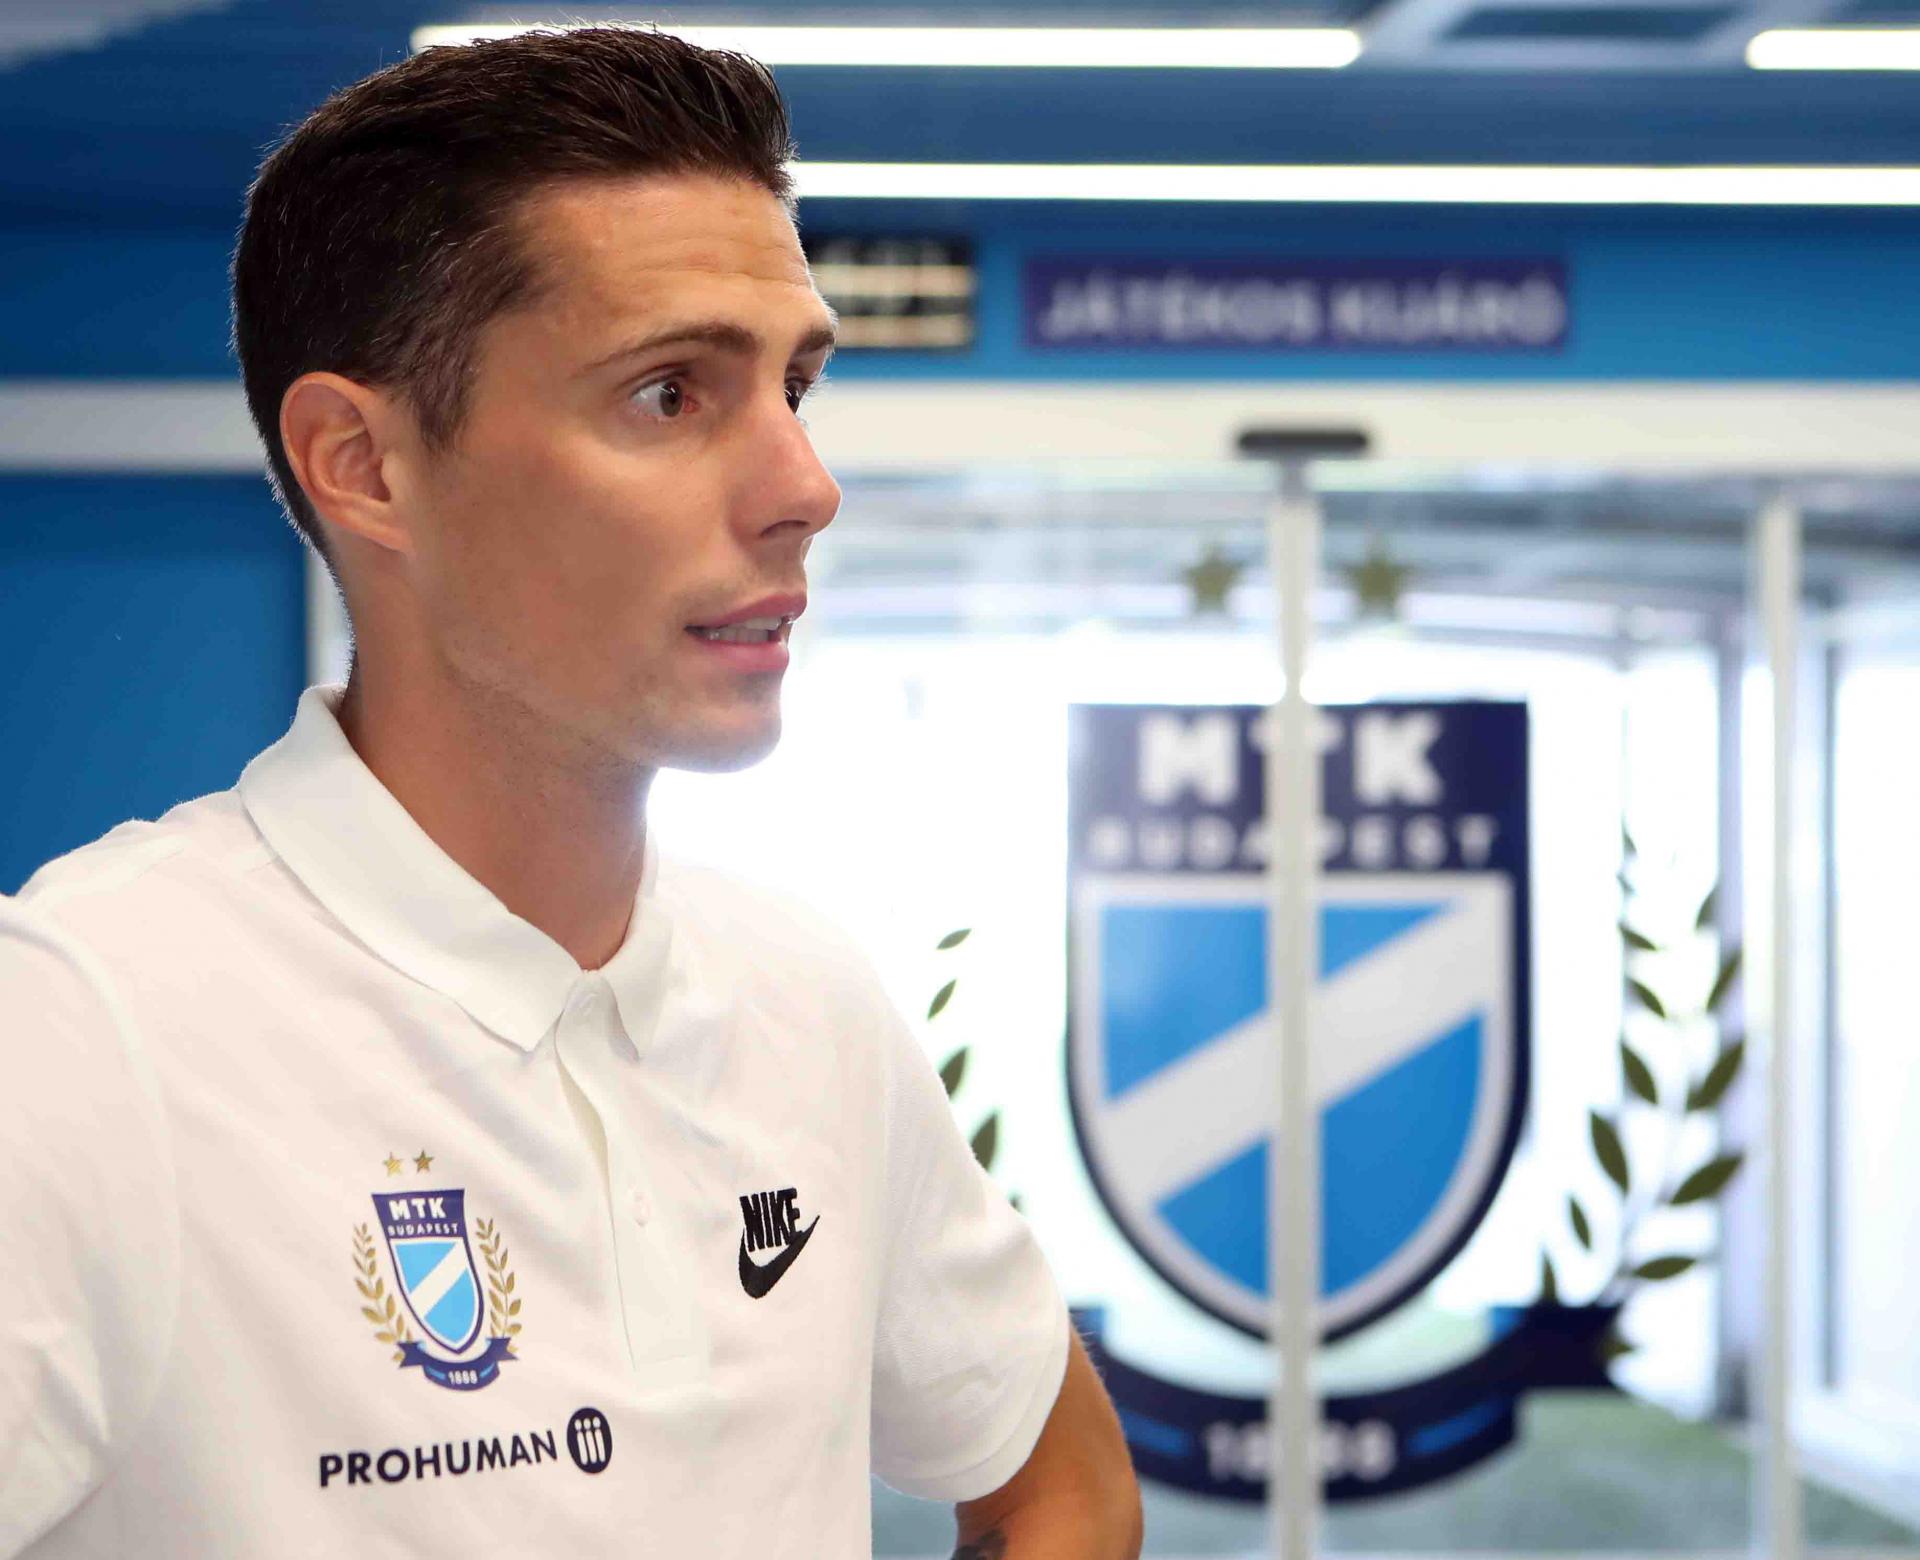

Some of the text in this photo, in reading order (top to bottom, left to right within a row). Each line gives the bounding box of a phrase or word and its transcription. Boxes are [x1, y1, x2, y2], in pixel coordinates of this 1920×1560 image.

[388, 1197, 447, 1220] MTK
[739, 1187, 800, 1252] NIKE
[387, 1223, 458, 1236] BUDAPEST
[448, 1370, 478, 1385] 1888
[320, 1429, 558, 1488] PROHUMAN
